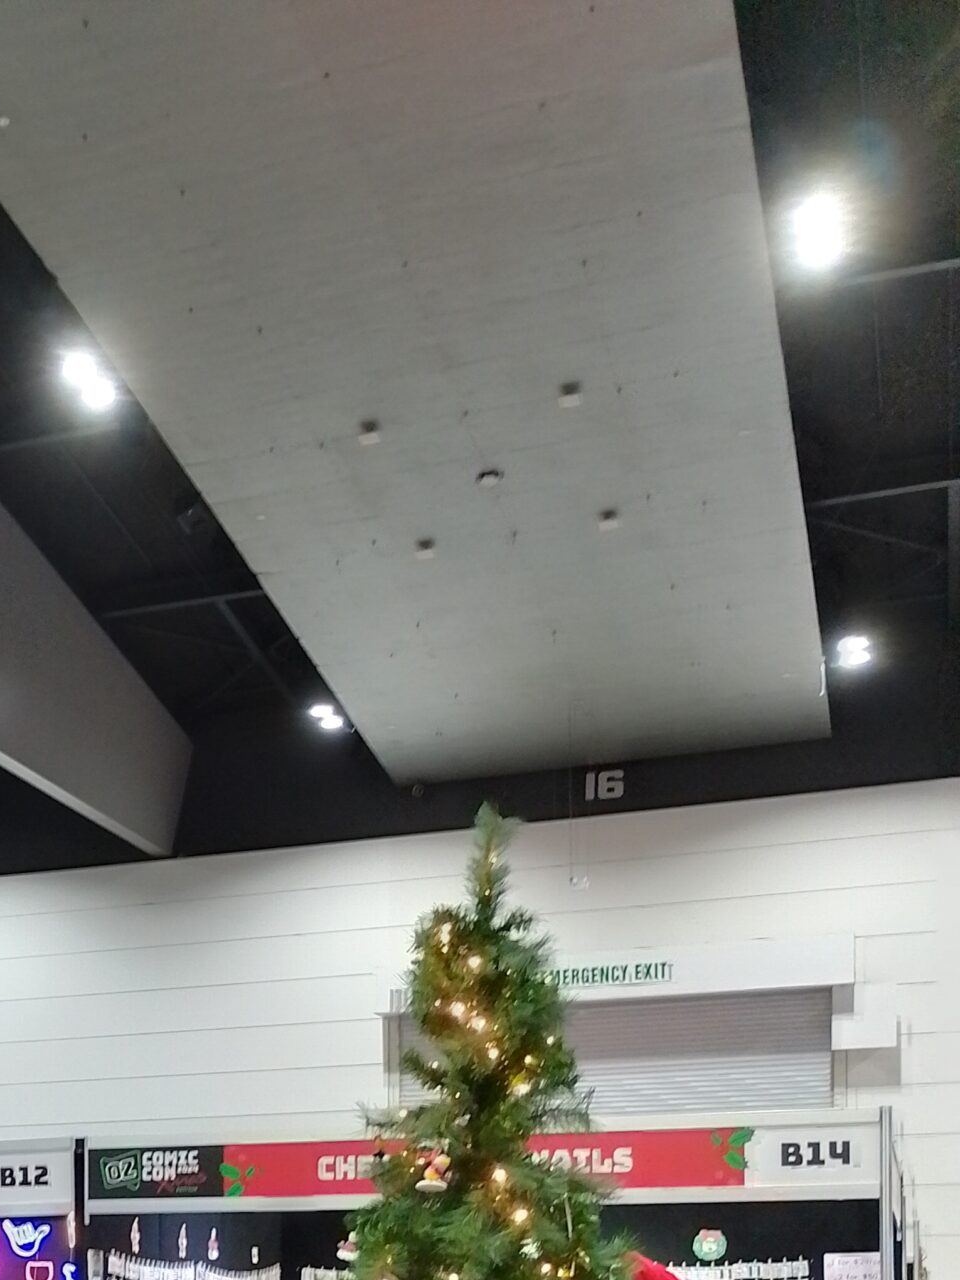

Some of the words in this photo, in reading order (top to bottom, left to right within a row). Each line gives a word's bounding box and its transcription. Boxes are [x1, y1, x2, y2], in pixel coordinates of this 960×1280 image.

[585, 769, 624, 801] 16
[634, 962, 667, 981] EXIT
[142, 1150, 199, 1167] COMIC
[781, 1141, 850, 1166] B14
[0, 1165, 49, 1187] B12
[142, 1165, 176, 1181] CON
